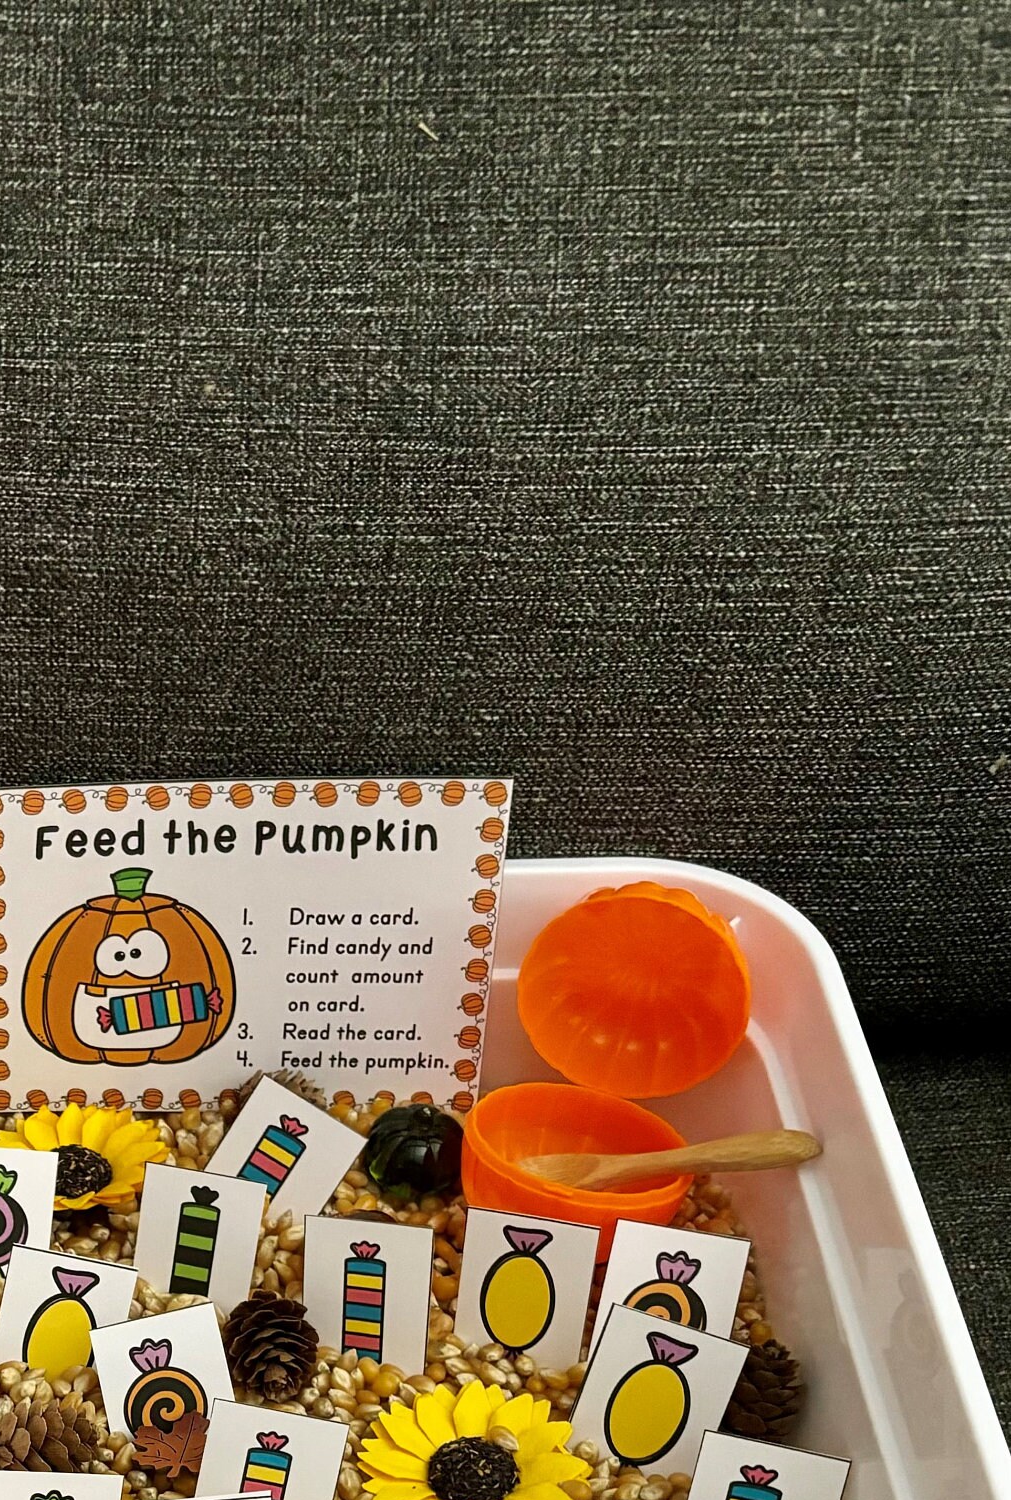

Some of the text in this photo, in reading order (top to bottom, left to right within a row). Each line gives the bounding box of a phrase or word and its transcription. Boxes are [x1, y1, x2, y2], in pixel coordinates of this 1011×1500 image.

[35, 818, 438, 861] Feed the Pumpkin
[243, 906, 419, 926] 1. Draw a card.
[241, 936, 434, 962] 2. Find candy and
[285, 969, 424, 984] count amount
[287, 994, 366, 1014] on card.
[237, 1022, 422, 1041] 3. Read the card.
[236, 1050, 450, 1076] 4. Feed the pumpkin.
